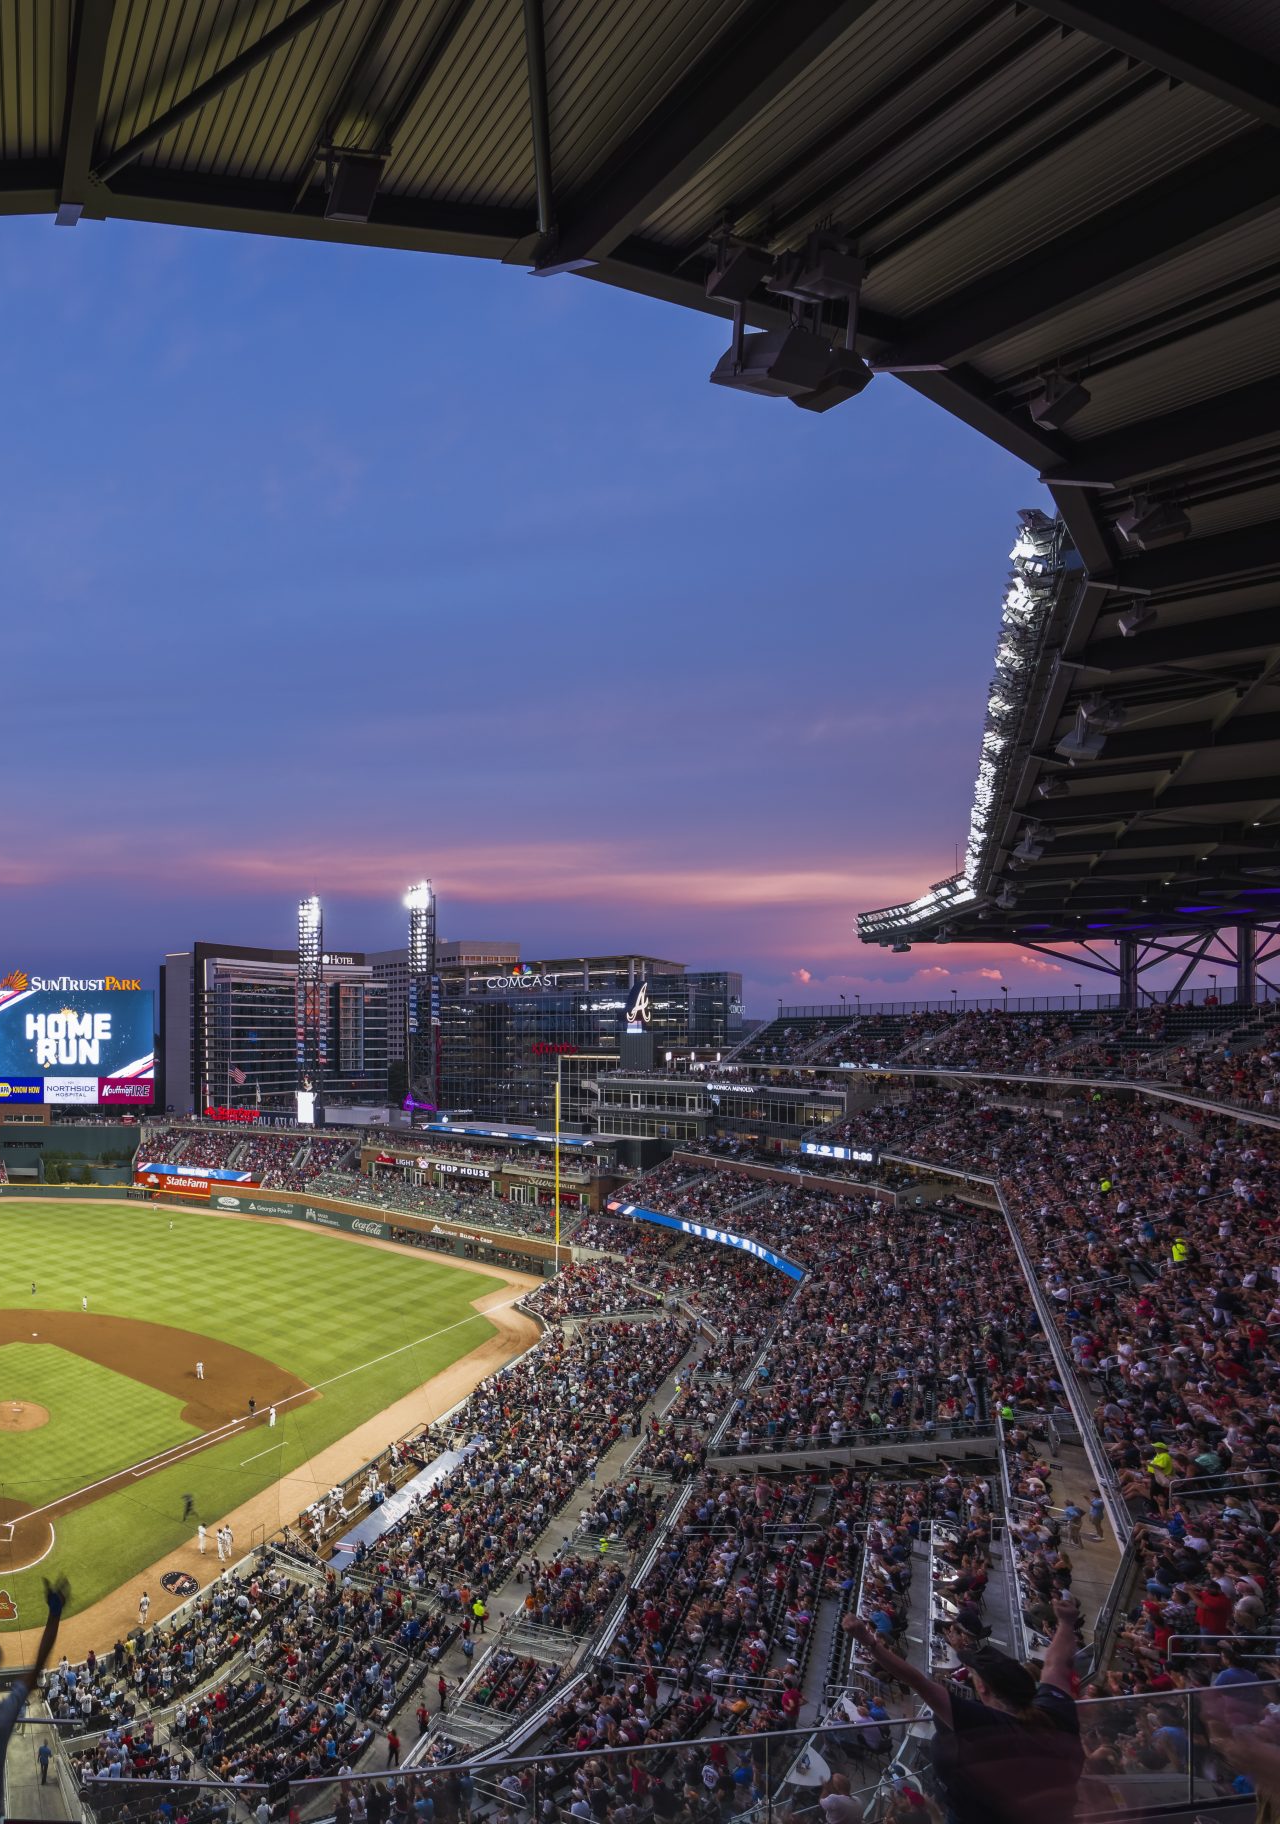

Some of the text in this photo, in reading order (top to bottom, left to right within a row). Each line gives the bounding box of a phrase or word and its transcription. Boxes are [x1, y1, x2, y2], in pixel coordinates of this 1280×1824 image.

[330, 955, 355, 965] HOTEL
[486, 974, 561, 989] COMCAST
[25, 1012, 112, 1040] HOME
[36, 1038, 100, 1065] RUN
[28, 1086, 40, 1094] HOW
[395, 1158, 414, 1167] LIGHT
[435, 1163, 490, 1178] CHOP HOUSE
[256, 1205, 293, 1215] Georgia Power
